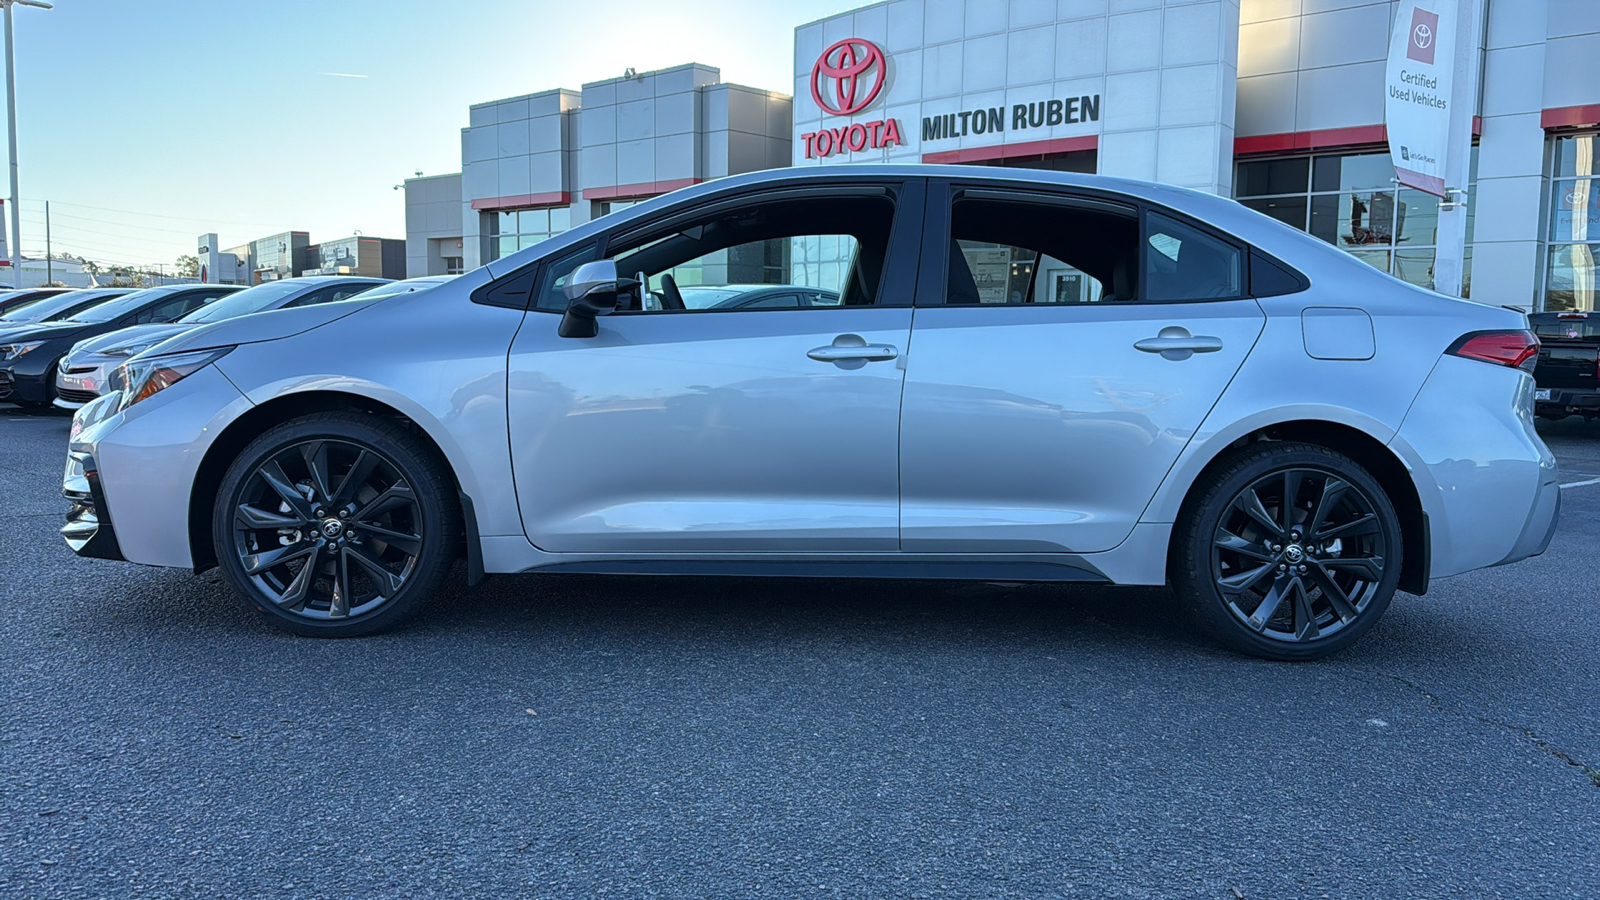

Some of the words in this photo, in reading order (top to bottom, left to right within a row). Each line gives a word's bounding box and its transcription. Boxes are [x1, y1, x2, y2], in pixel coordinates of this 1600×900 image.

[1400, 70, 1437, 89] Certified
[1389, 85, 1410, 101] Used
[1411, 90, 1446, 109] Vehicles
[922, 106, 1005, 141] MILTON
[1012, 94, 1100, 130] RUBEN
[801, 118, 901, 159] TOYOTA
